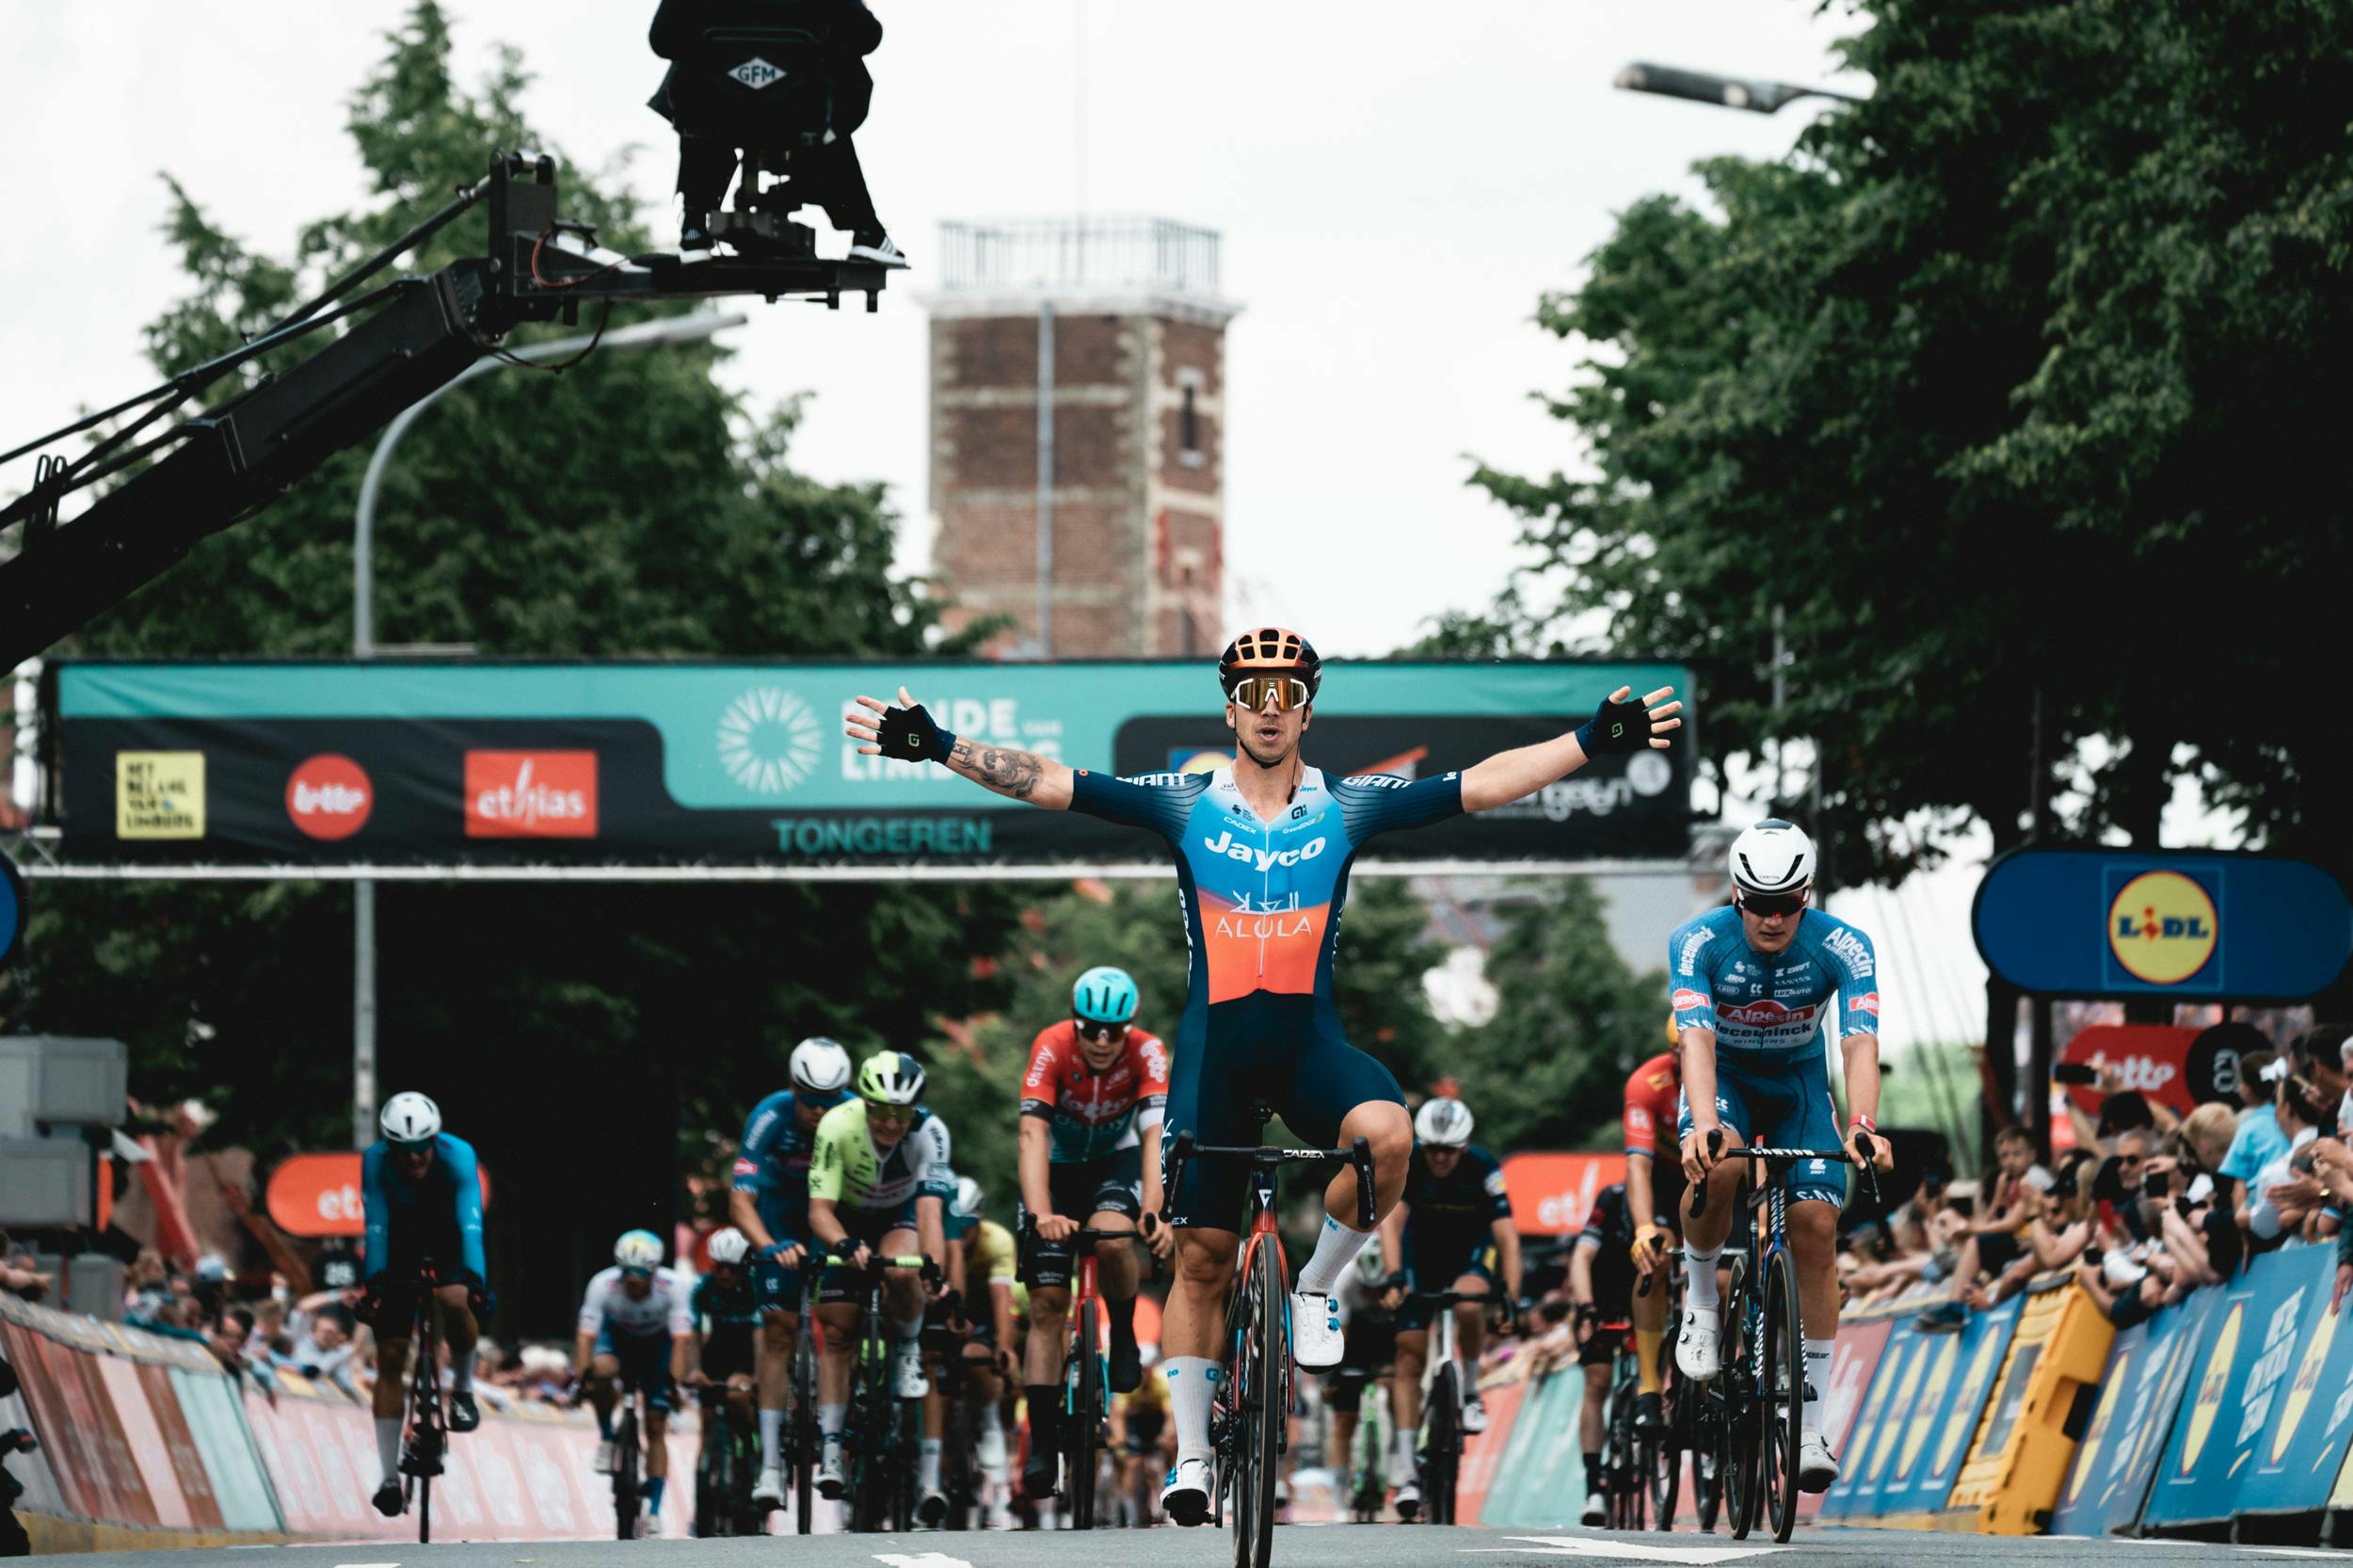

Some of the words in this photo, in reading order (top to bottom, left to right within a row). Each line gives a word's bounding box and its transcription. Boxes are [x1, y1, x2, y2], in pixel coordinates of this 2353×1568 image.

[737, 66, 776, 83] GFM
[477, 759, 585, 827] ethias
[1341, 775, 1413, 790] GIANT
[770, 818, 992, 854] TONGEREN
[1224, 816, 1257, 835] CADEX
[1204, 830, 1326, 872] Jayco
[1215, 916, 1312, 939] ALULA
[1824, 926, 1873, 977] Alpecin
[1726, 1009, 1804, 1023] Alpecin
[1283, 1149, 1325, 1159] CADEX
